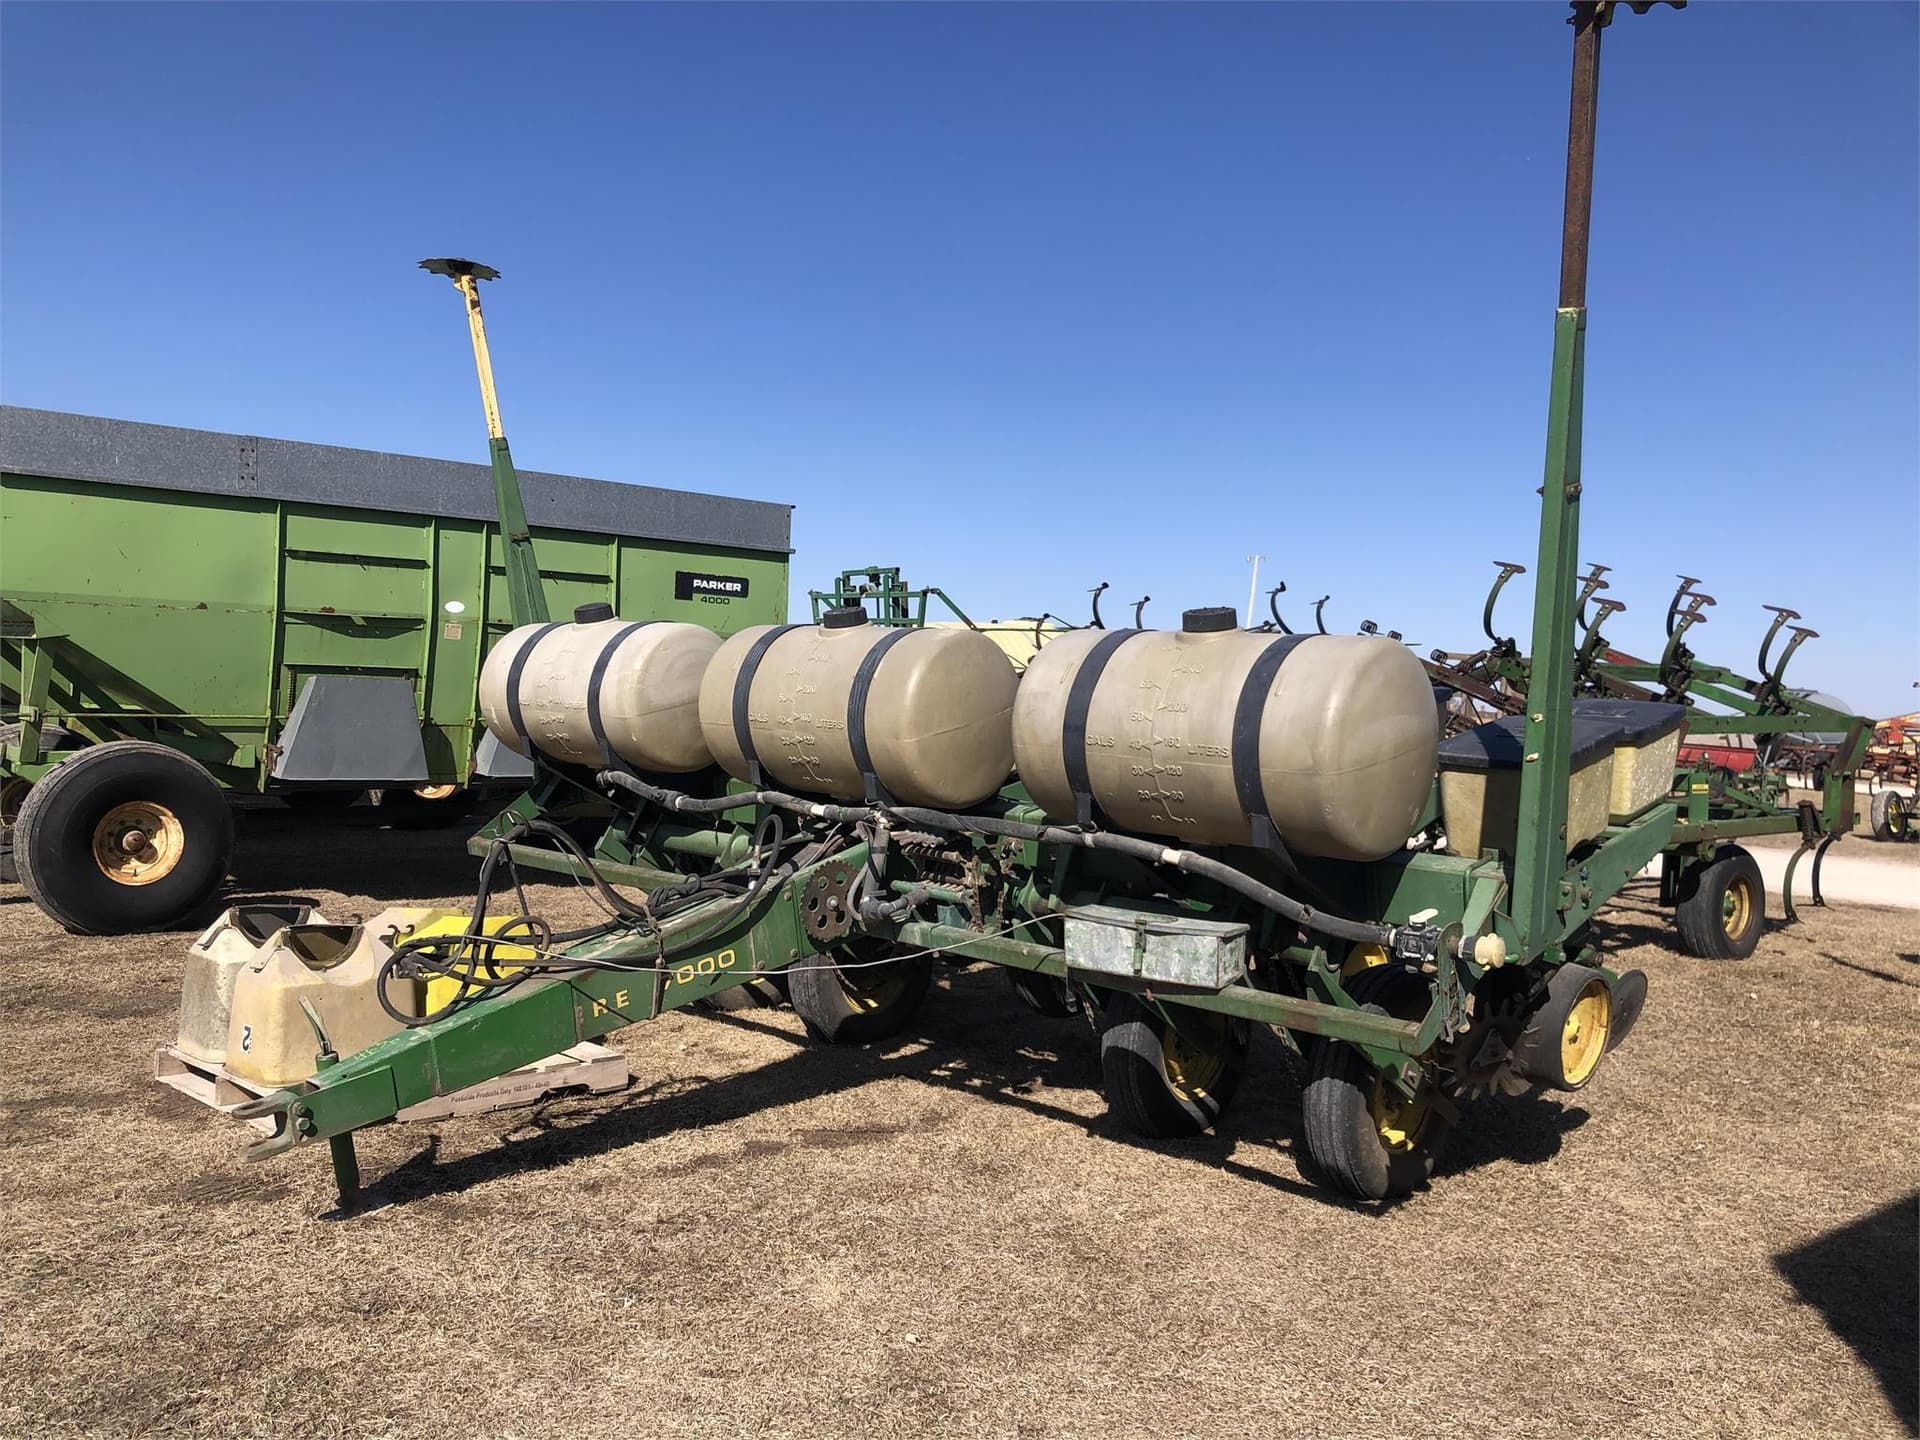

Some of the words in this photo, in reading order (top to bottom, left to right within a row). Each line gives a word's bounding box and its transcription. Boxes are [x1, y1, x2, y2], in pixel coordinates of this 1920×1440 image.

[693, 579, 741, 592] PARKER
[701, 596, 730, 605] 4000
[815, 718, 844, 730] LITERS
[1087, 735, 1115, 748] GALS
[1129, 740, 1143, 750] 40
[1187, 744, 1230, 758] LITERS
[476, 1091, 499, 1099] Products
